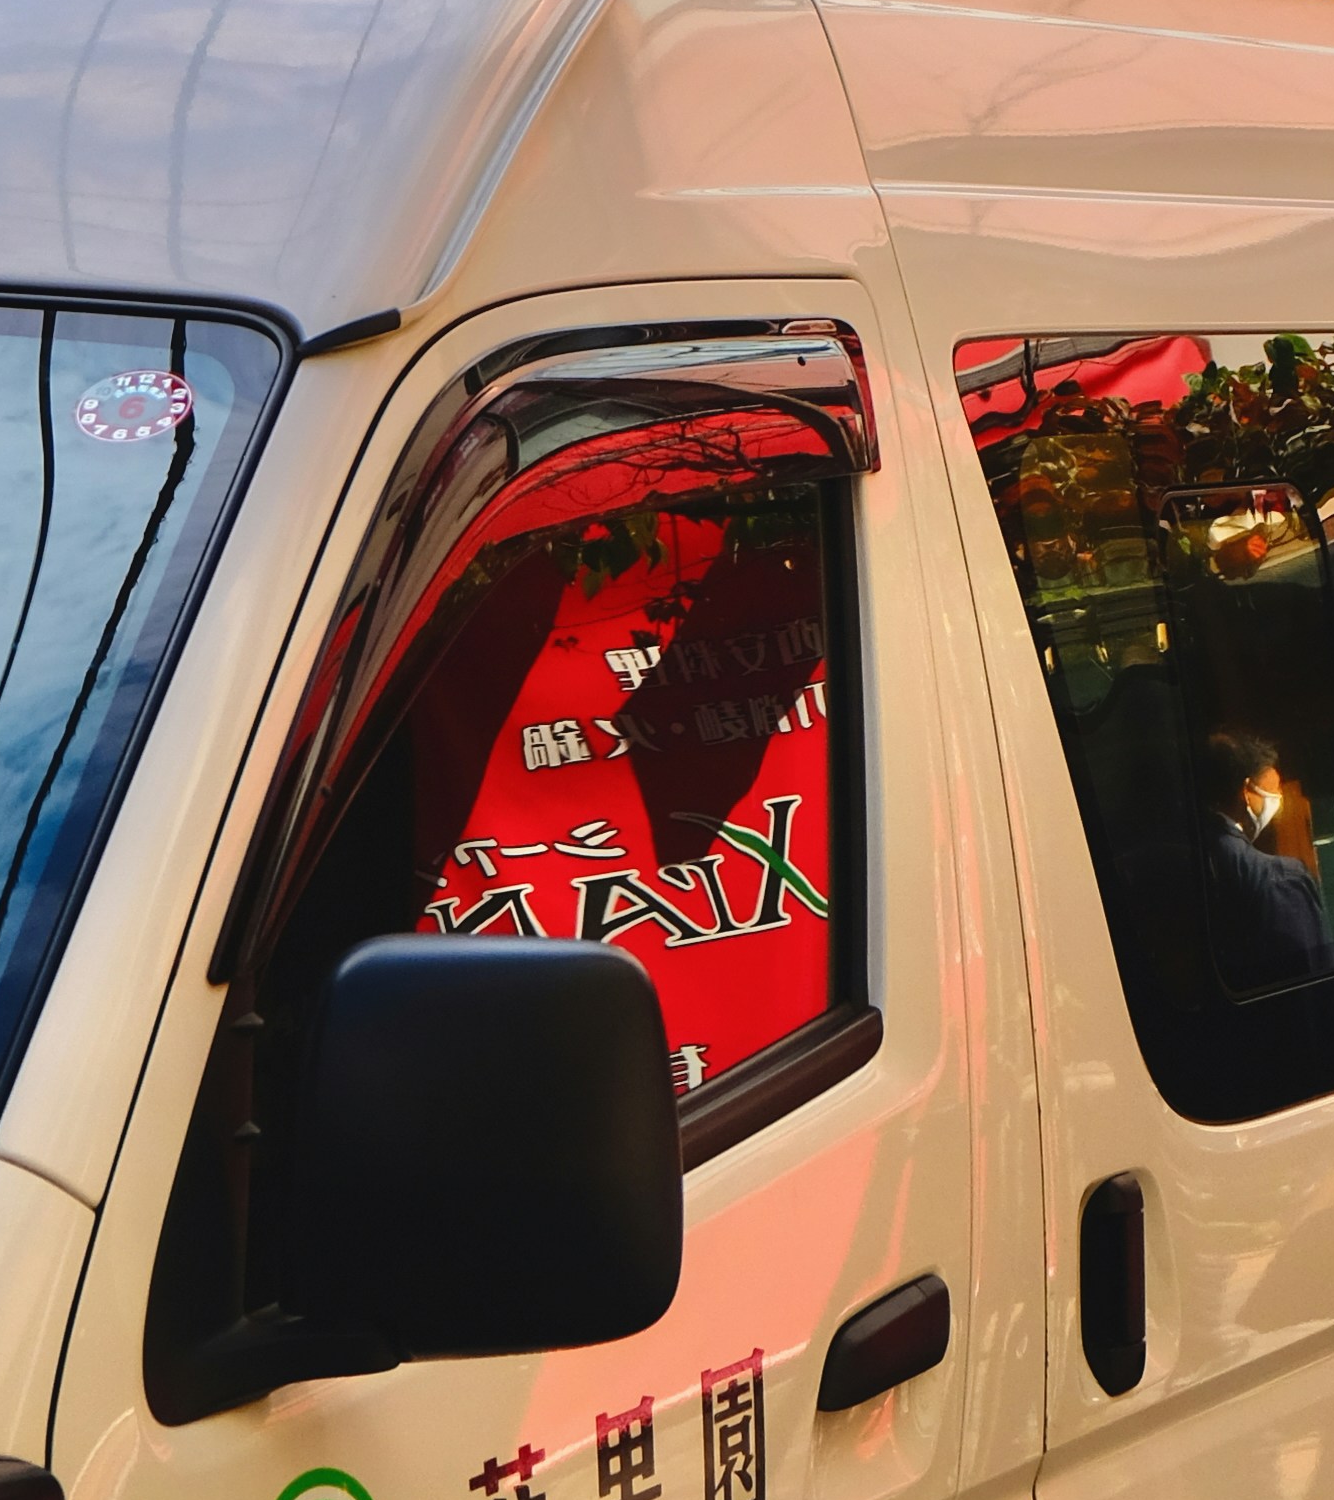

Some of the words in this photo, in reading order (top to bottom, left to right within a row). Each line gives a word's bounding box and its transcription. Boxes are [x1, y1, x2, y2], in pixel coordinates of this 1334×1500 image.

[116, 376, 132, 386] 11
[139, 373, 156, 384] 12
[171, 388, 187, 399] 2
[170, 402, 186, 414] 3
[93, 424, 109, 435] 7
[112, 428, 128, 439] 6
[136, 426, 152, 437] 5
